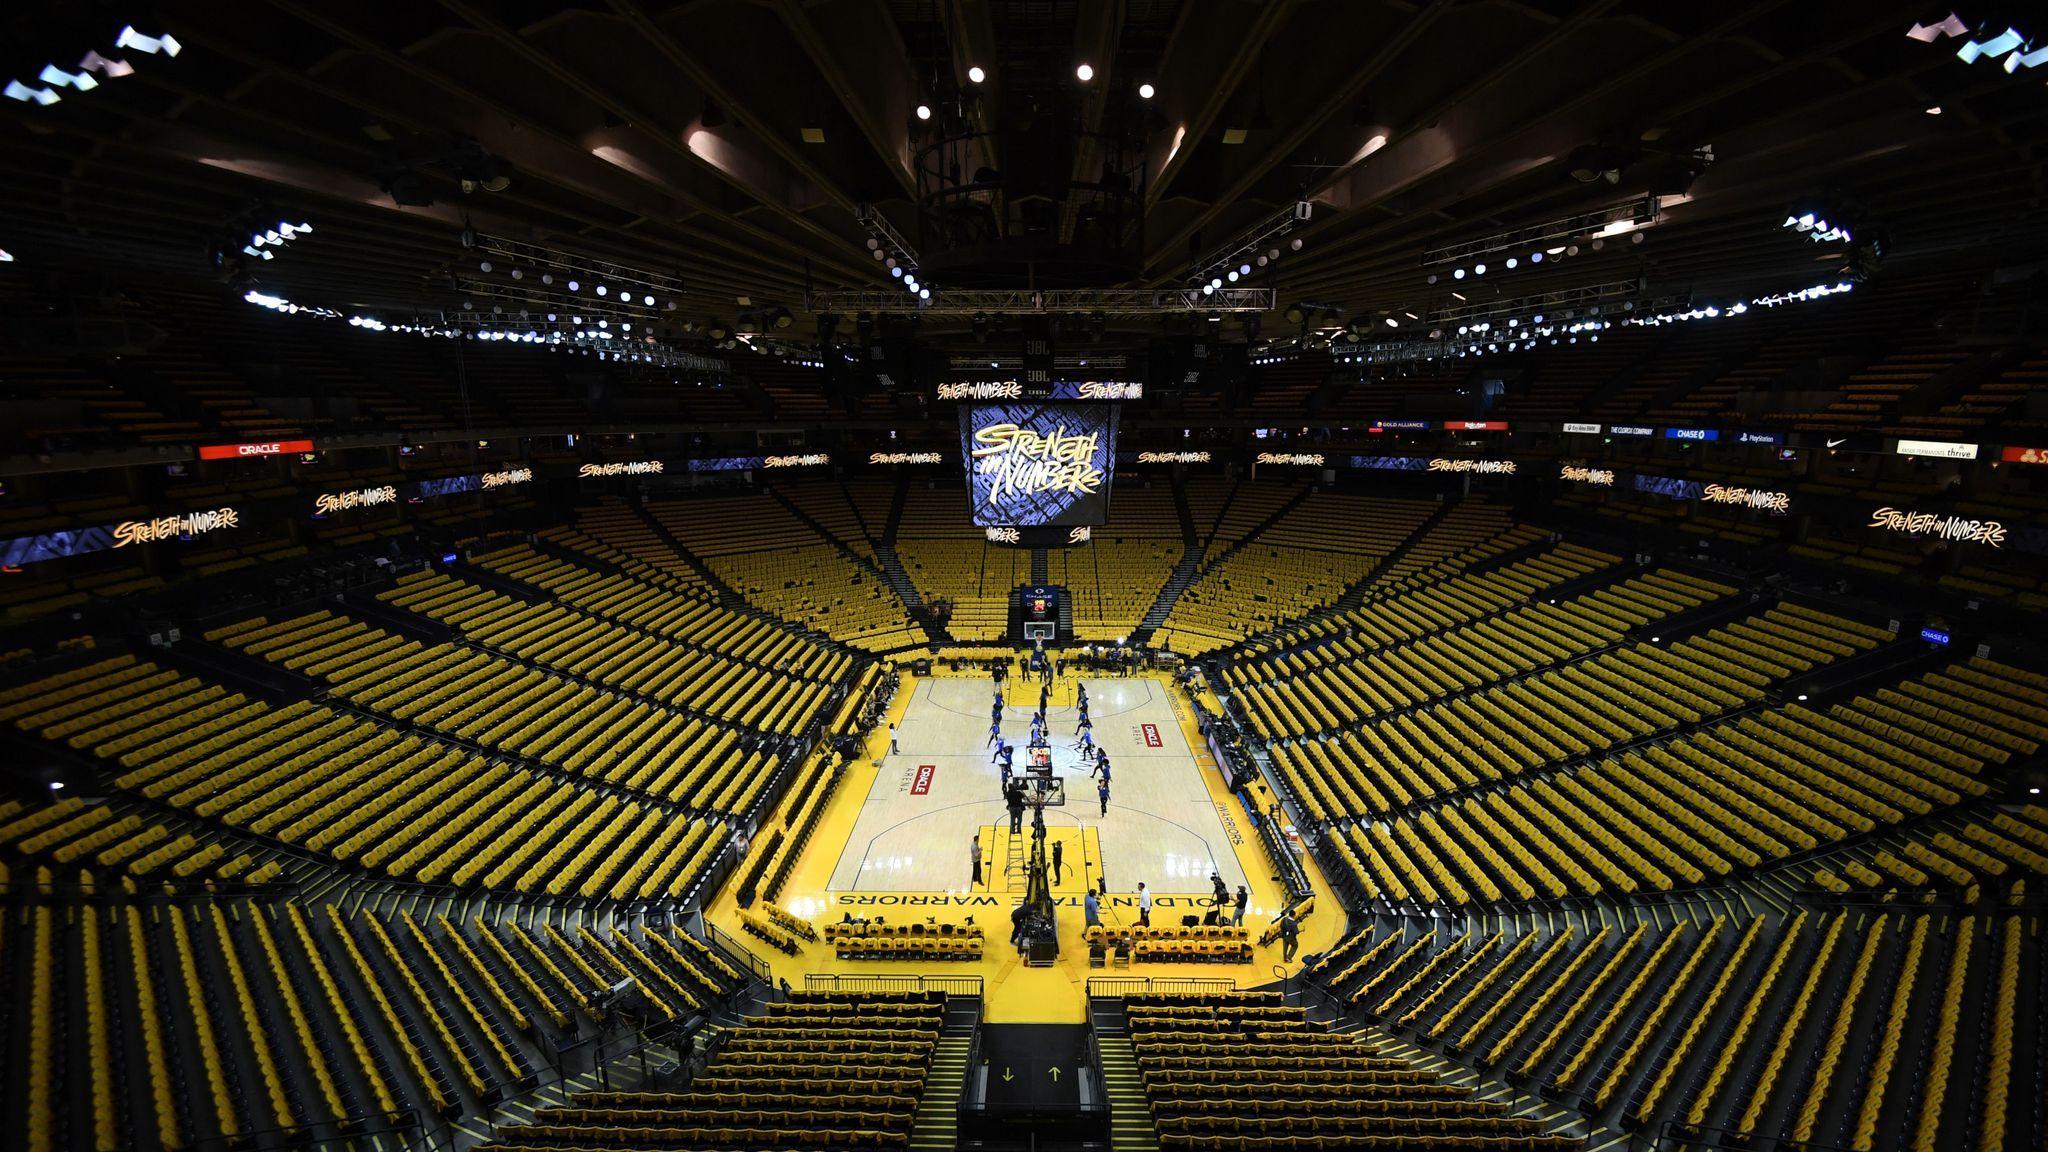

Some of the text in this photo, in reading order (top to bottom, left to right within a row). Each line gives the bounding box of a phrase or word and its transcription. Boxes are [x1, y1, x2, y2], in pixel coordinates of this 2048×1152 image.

[1028, 370, 1050, 382] JBL
[938, 382, 970, 400] STRENGTH
[1677, 429, 1698, 439] CHASE
[1749, 434, 1774, 443] PlayStation
[239, 444, 280, 455] ORACLE
[972, 424, 1099, 463] STRENGTH
[868, 453, 907, 464] STRENGTH
[1137, 452, 1176, 463] STRENGTH
[1947, 448, 1971, 458] thrive
[578, 462, 624, 478] STRENGTH
[1427, 459, 1474, 472] STRENGTH
[990, 457, 1101, 505] NUMBERS
[315, 490, 359, 515] STRENGTH
[1701, 484, 1748, 505] STRENGTH
[112, 515, 180, 548] STRENGTH
[189, 508, 239, 536] NUMBERS
[1868, 507, 1938, 534] STRENGTH
[1940, 516, 2008, 548] NUMBERS
[1921, 630, 1942, 641] CHASE
[1145, 725, 1160, 746] ORACLE
[899, 768, 915, 792] ARENA
[915, 767, 931, 792] ORACLE
[839, 895, 998, 905] WARRIORS
